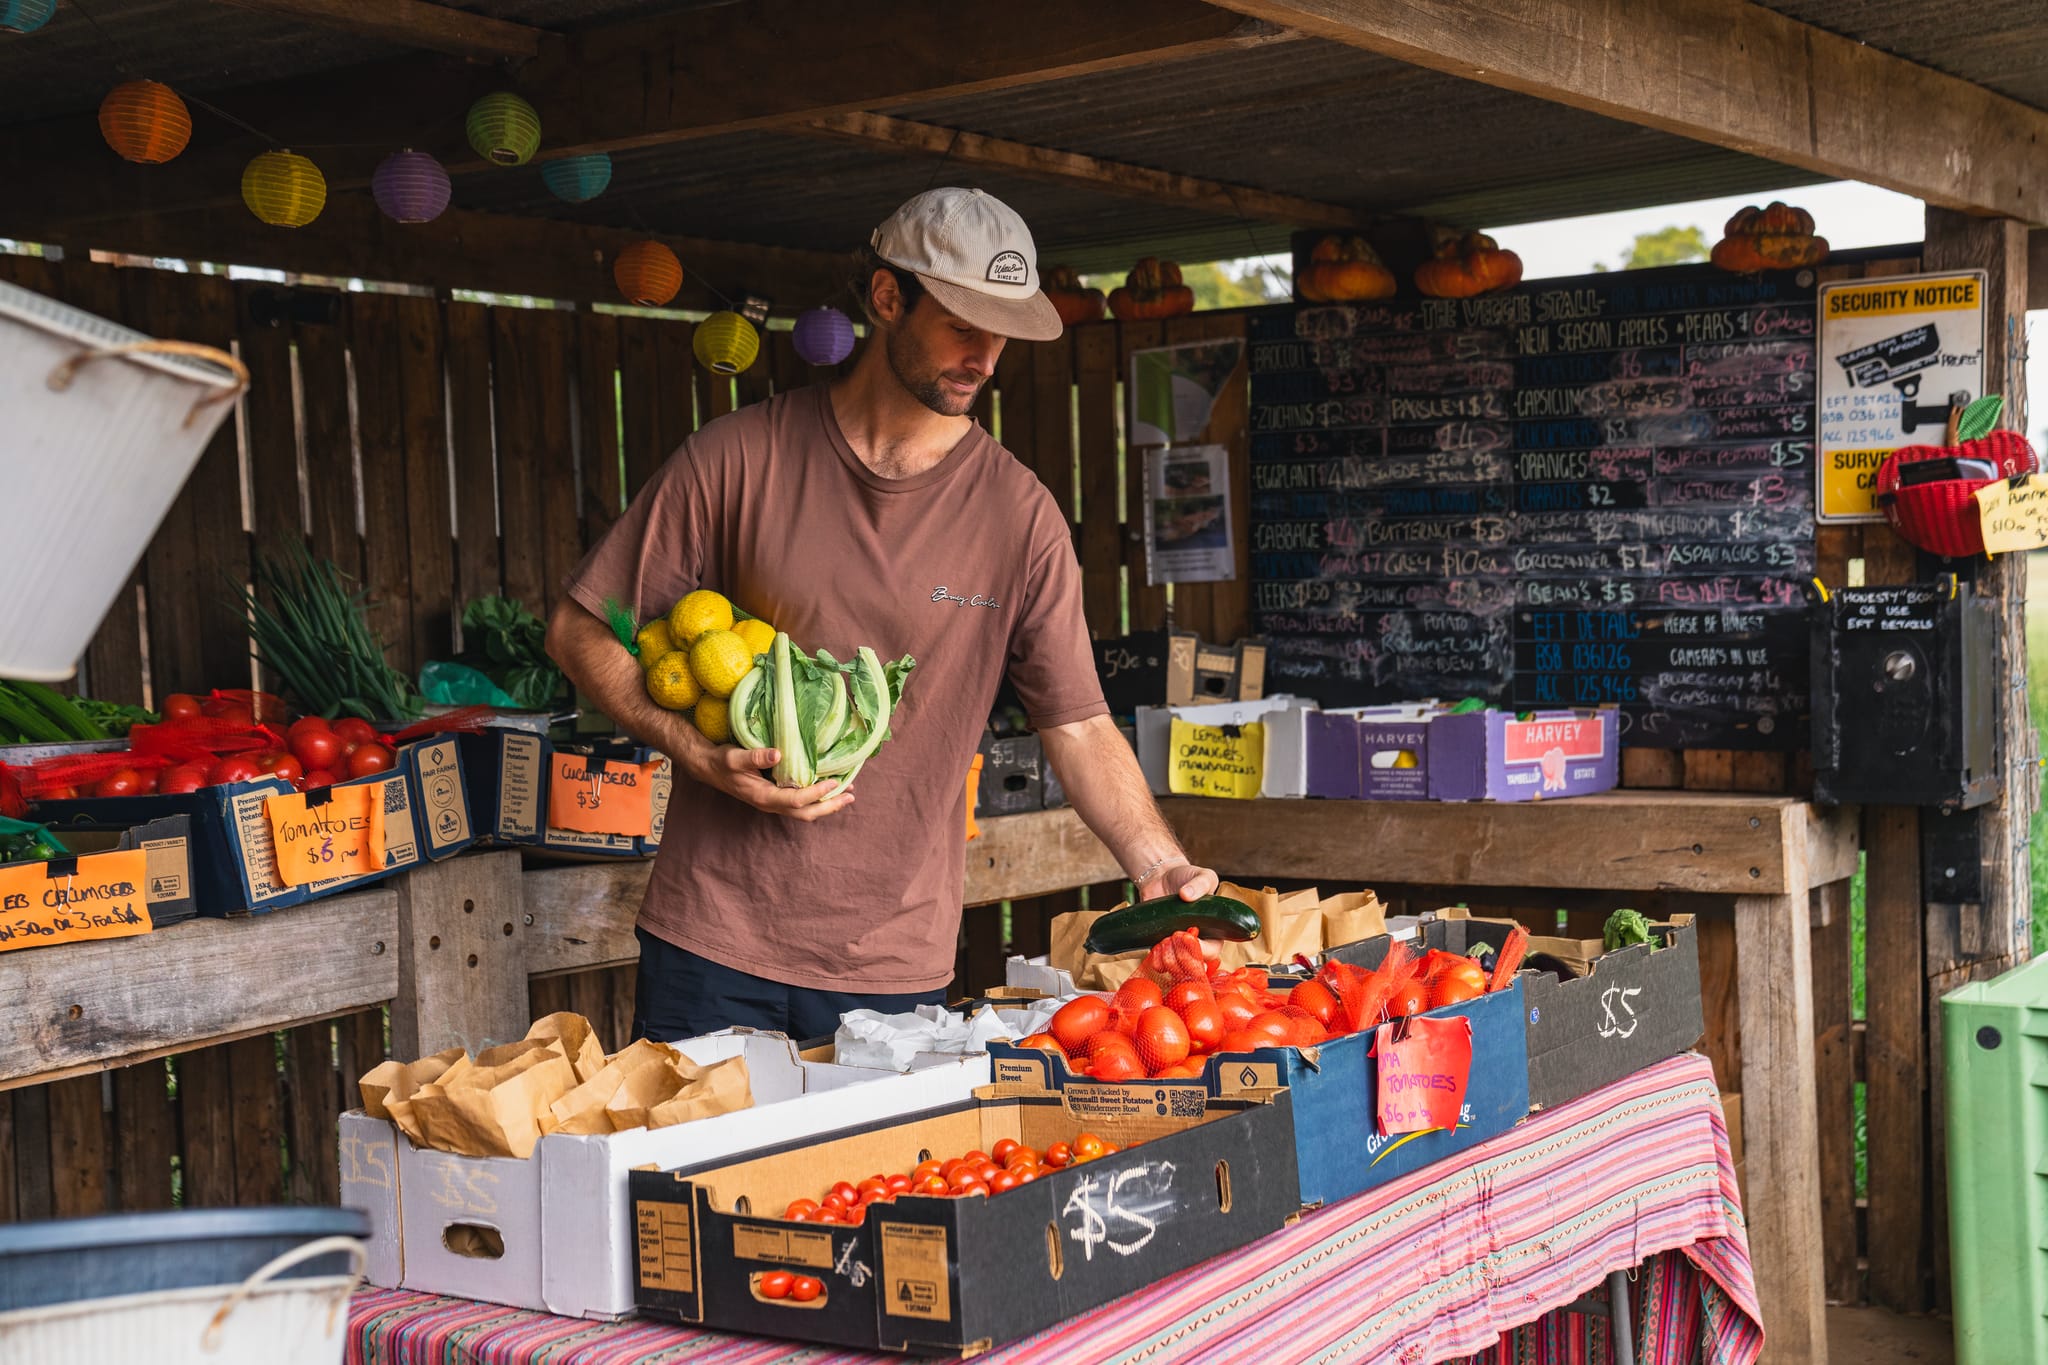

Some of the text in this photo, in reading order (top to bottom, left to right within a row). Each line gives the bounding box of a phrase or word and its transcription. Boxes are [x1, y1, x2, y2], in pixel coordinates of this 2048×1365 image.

[1830, 284, 1974, 314] SECURITY NOTICE
[1519, 315, 1668, 354] NEW SEASON APPLES
[1684, 310, 1734, 341] PEARS
[1827, 395, 1848, 409] EFT
[1519, 451, 1588, 480] ORANGES
[1587, 485, 1616, 506] $2
[1255, 522, 1320, 551] CABBAGE
[1666, 543, 1797, 566] ASPARAGUS $3
[1600, 576, 1636, 604] $5
[1659, 580, 1756, 603] FENNEL
[1859, 605, 1911, 616] OR USE
[1533, 612, 1641, 640] EFT DETAILS
[1664, 615, 1698, 634] PLEASE
[1722, 614, 1766, 633] HONEST
[1847, 618, 1934, 631] EFT DETAILS
[1535, 643, 1562, 670] BSB
[1573, 643, 1632, 670] 036126
[1535, 675, 1562, 703] ACC
[1573, 675, 1637, 703] 125946
[1365, 732, 1426, 744] HARVEY
[1525, 723, 1582, 744] HARVEY
[422, 763, 457, 779] FAIR FARMS
[561, 763, 638, 787] CUCUBERS
[238, 803, 259, 815] Sweet
[240, 812, 264, 823] Potato
[547, 834, 570, 842] Product
[1597, 980, 1643, 1040] $5
[1000, 1063, 1033, 1074] Premium
[1000, 1073, 1022, 1083] Sweet
[1067, 1087, 1130, 1098] Grown & Packed by
[1386, 1073, 1457, 1094] TOMATOES
[1082, 1104, 1124, 1113] Windermere
[1124, 1105, 1141, 1114] Road
[1100, 1096, 1121, 1105] Sweet
[1121, 1096, 1154, 1106] Potatoes
[1384, 1102, 1403, 1123] $6
[1063, 1159, 1156, 1262] $5
